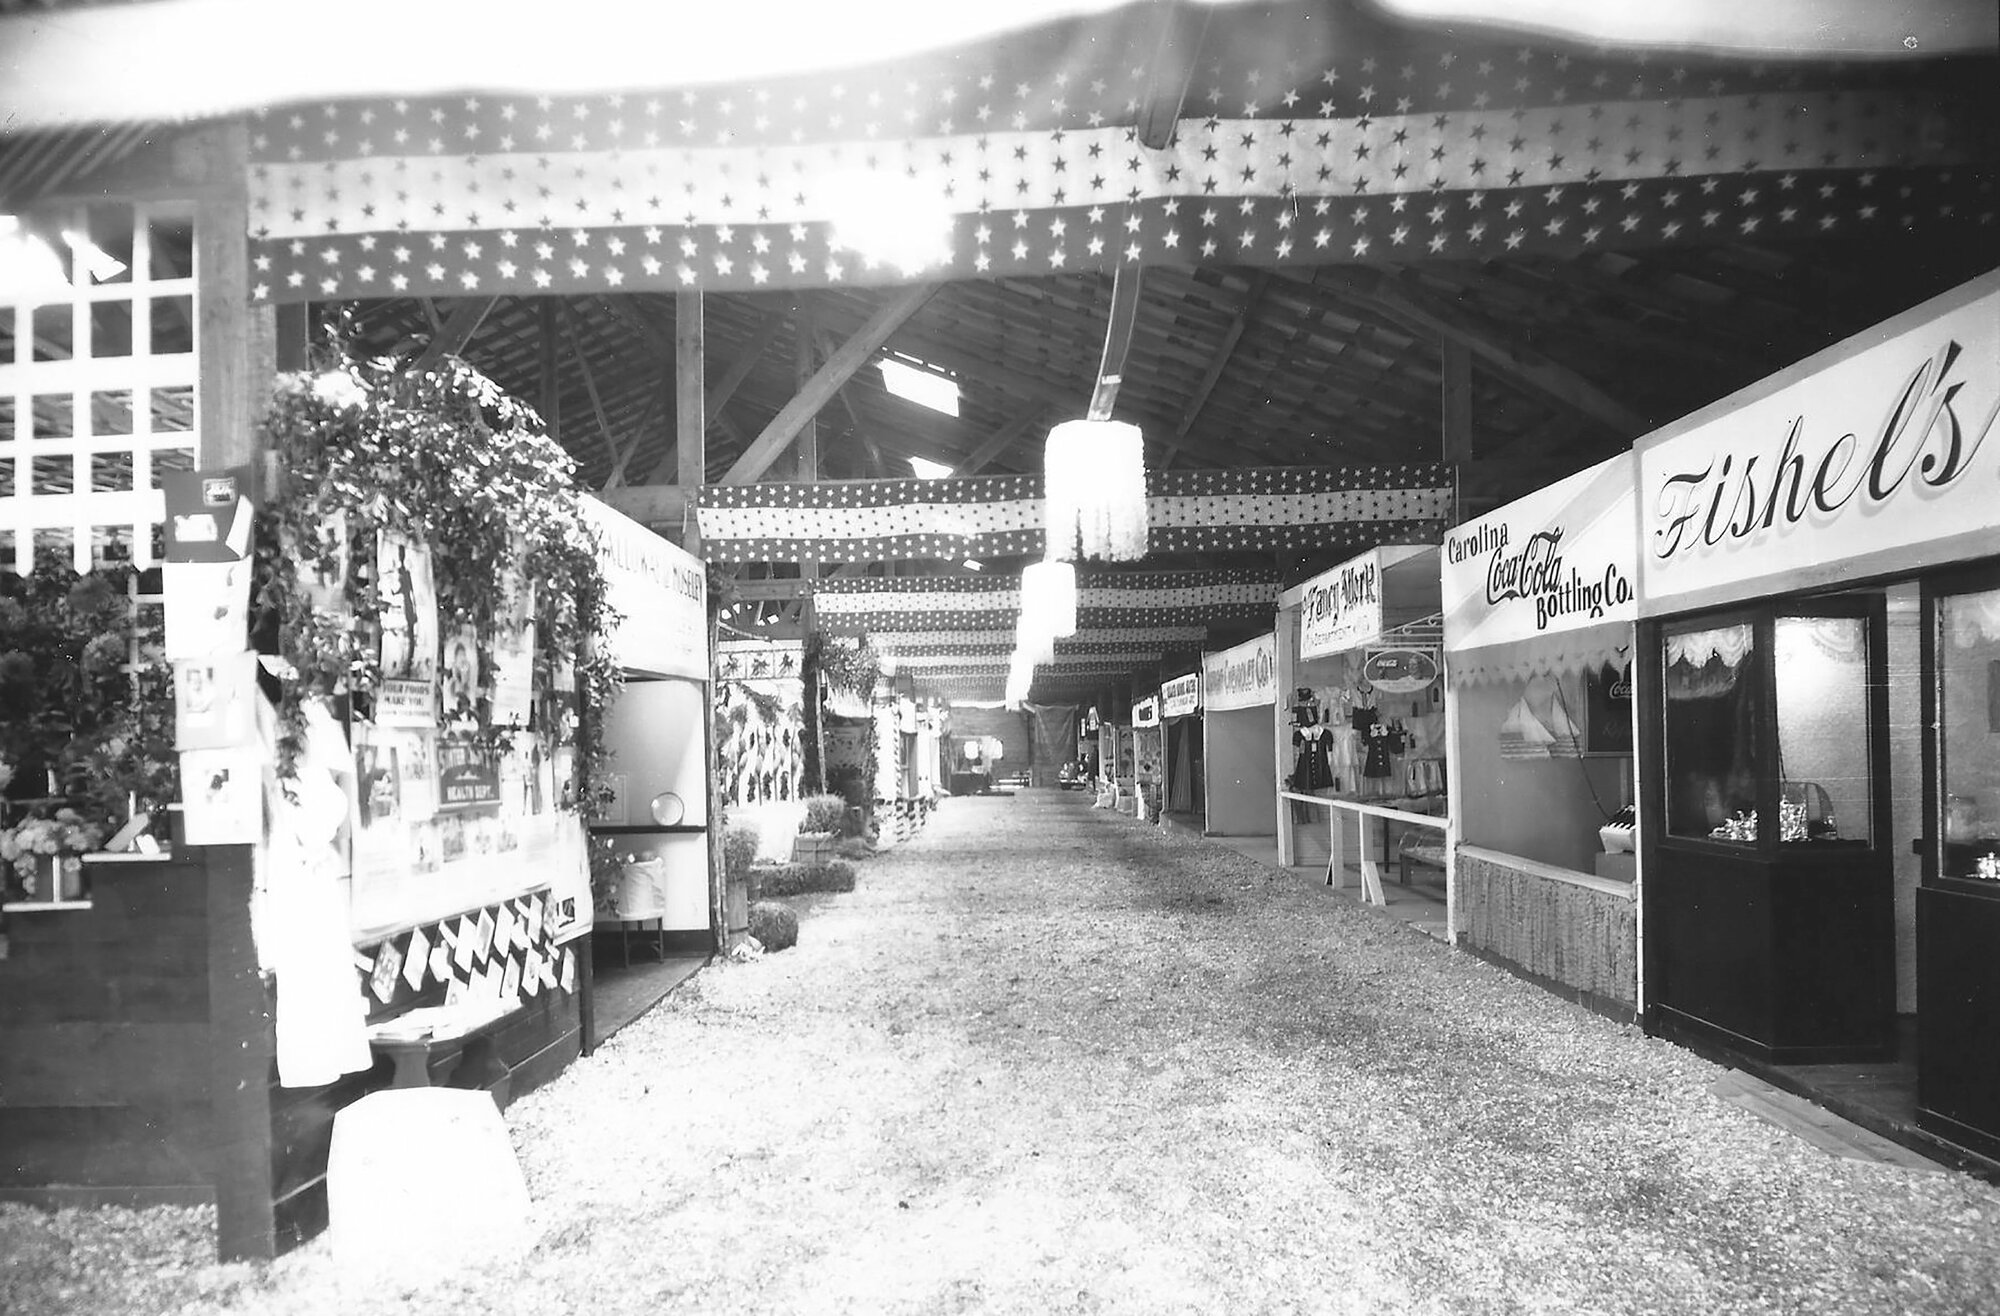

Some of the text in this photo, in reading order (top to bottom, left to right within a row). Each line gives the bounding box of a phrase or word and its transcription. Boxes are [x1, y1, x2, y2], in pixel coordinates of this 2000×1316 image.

[1654, 339, 1998, 559] Fishel's
[1448, 522, 1509, 565] Carolina
[1302, 584, 1340, 631] Fancy
[1340, 561, 1377, 613] Work
[1536, 562, 1635, 631] Bottling Co.
[384, 696, 405, 706] MAKE
[447, 785, 474, 801] HEALTH
